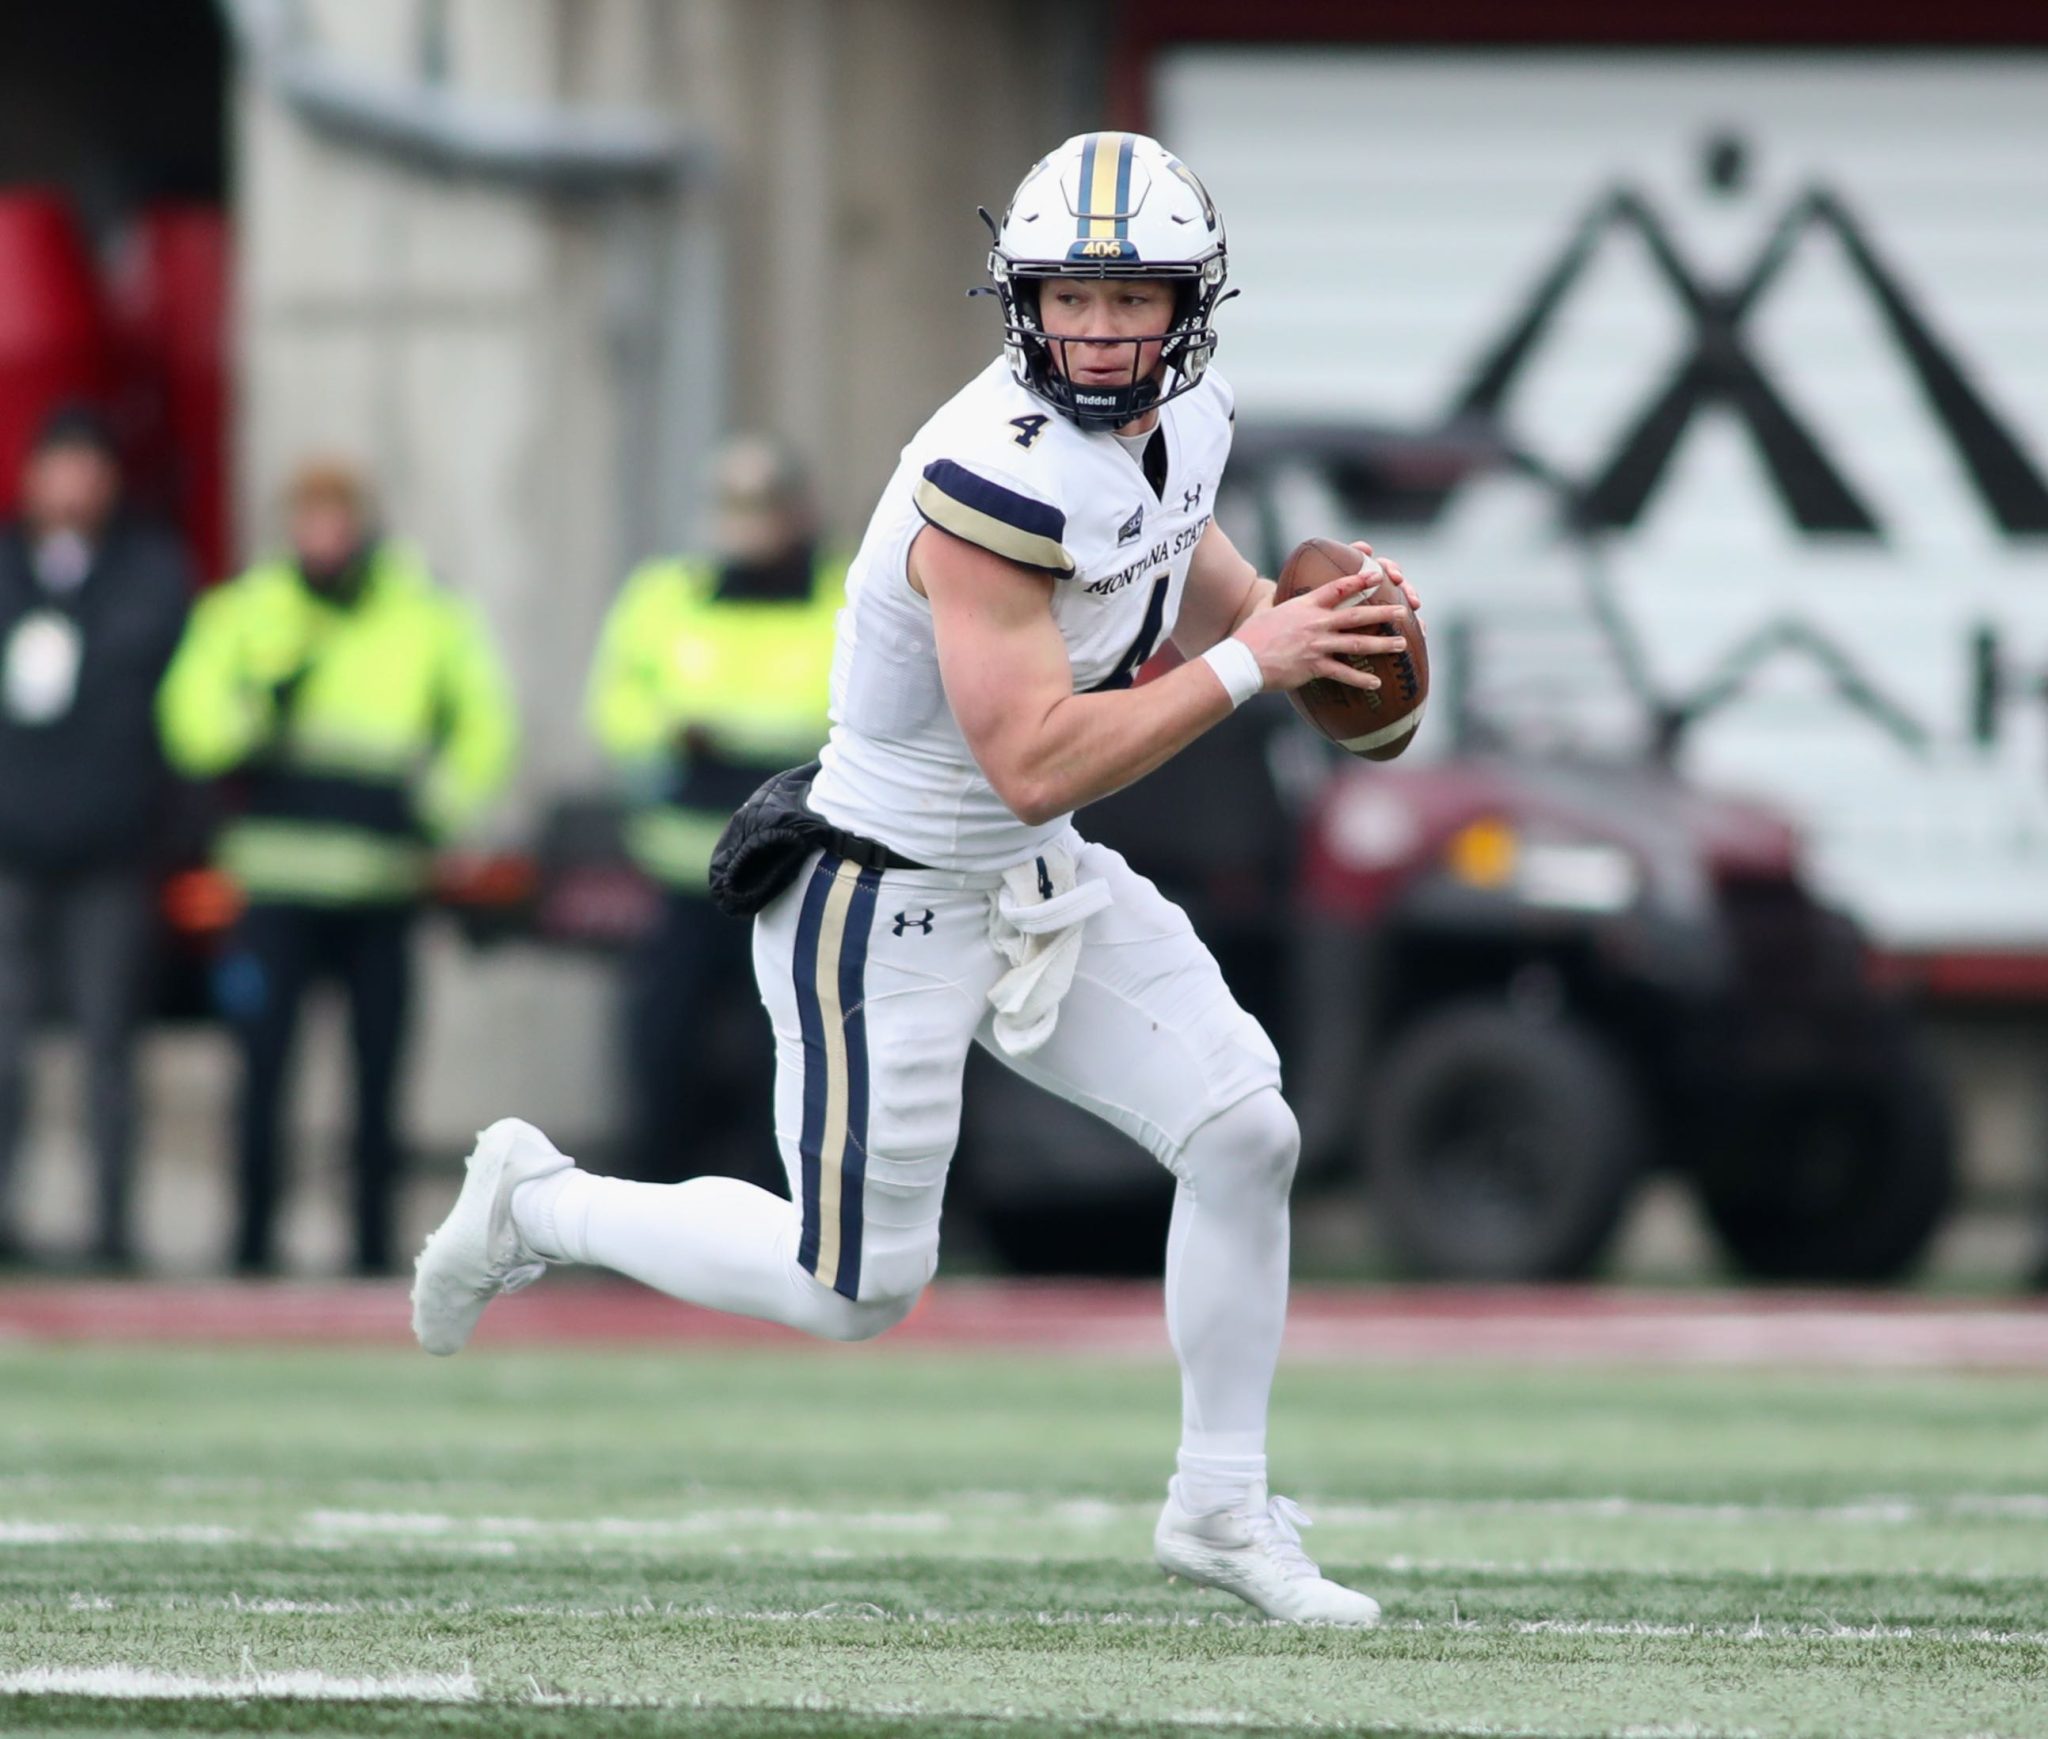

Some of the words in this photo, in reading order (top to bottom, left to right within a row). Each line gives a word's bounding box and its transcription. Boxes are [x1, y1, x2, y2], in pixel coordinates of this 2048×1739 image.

[1082, 241, 1121, 258] 406
[1075, 394, 1117, 406] Riddell
[1007, 413, 1051, 451] 4
[1083, 540, 1169, 595] MONTANA
[1036, 856, 1054, 900] 4
